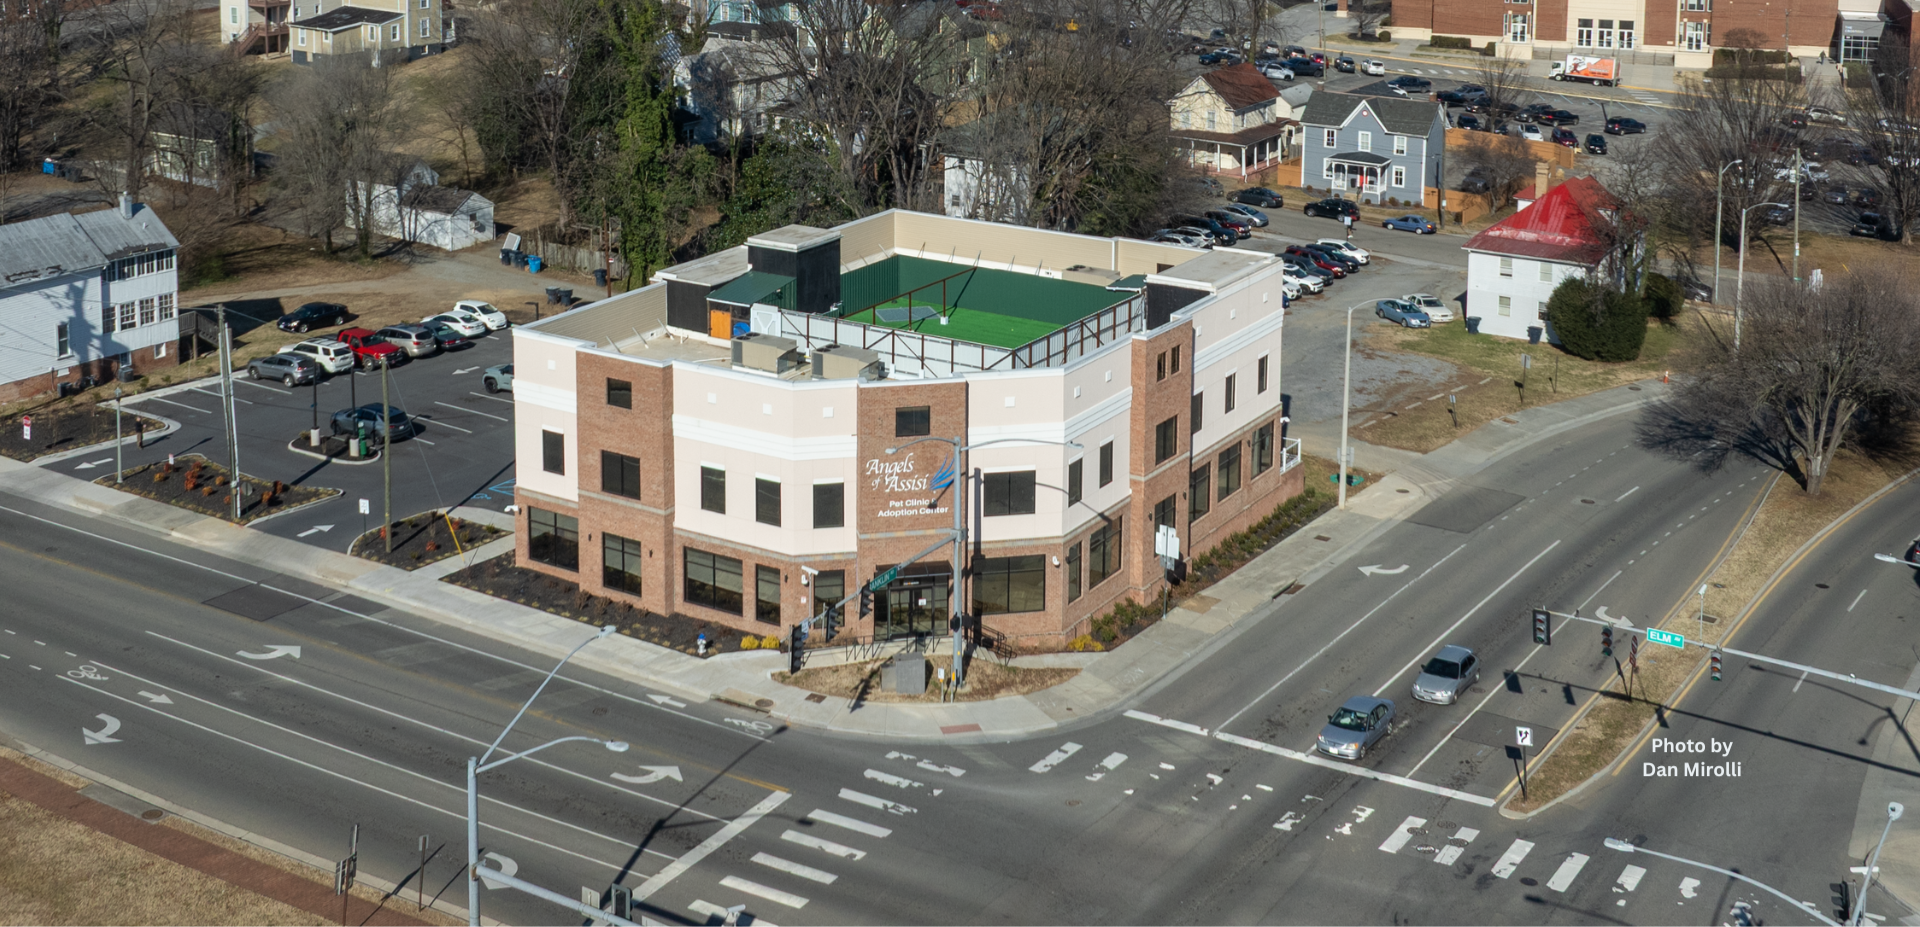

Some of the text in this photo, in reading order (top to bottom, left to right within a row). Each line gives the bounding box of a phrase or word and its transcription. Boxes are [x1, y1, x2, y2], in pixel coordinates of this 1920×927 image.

[866, 453, 914, 480] Angels
[871, 474, 929, 493] of Assisi
[889, 500, 904, 508] Pet
[905, 498, 930, 507] Clinic
[877, 506, 949, 518] Adoption Center
[869, 572, 890, 591] ANKLIN
[1650, 630, 1672, 643] ELM
